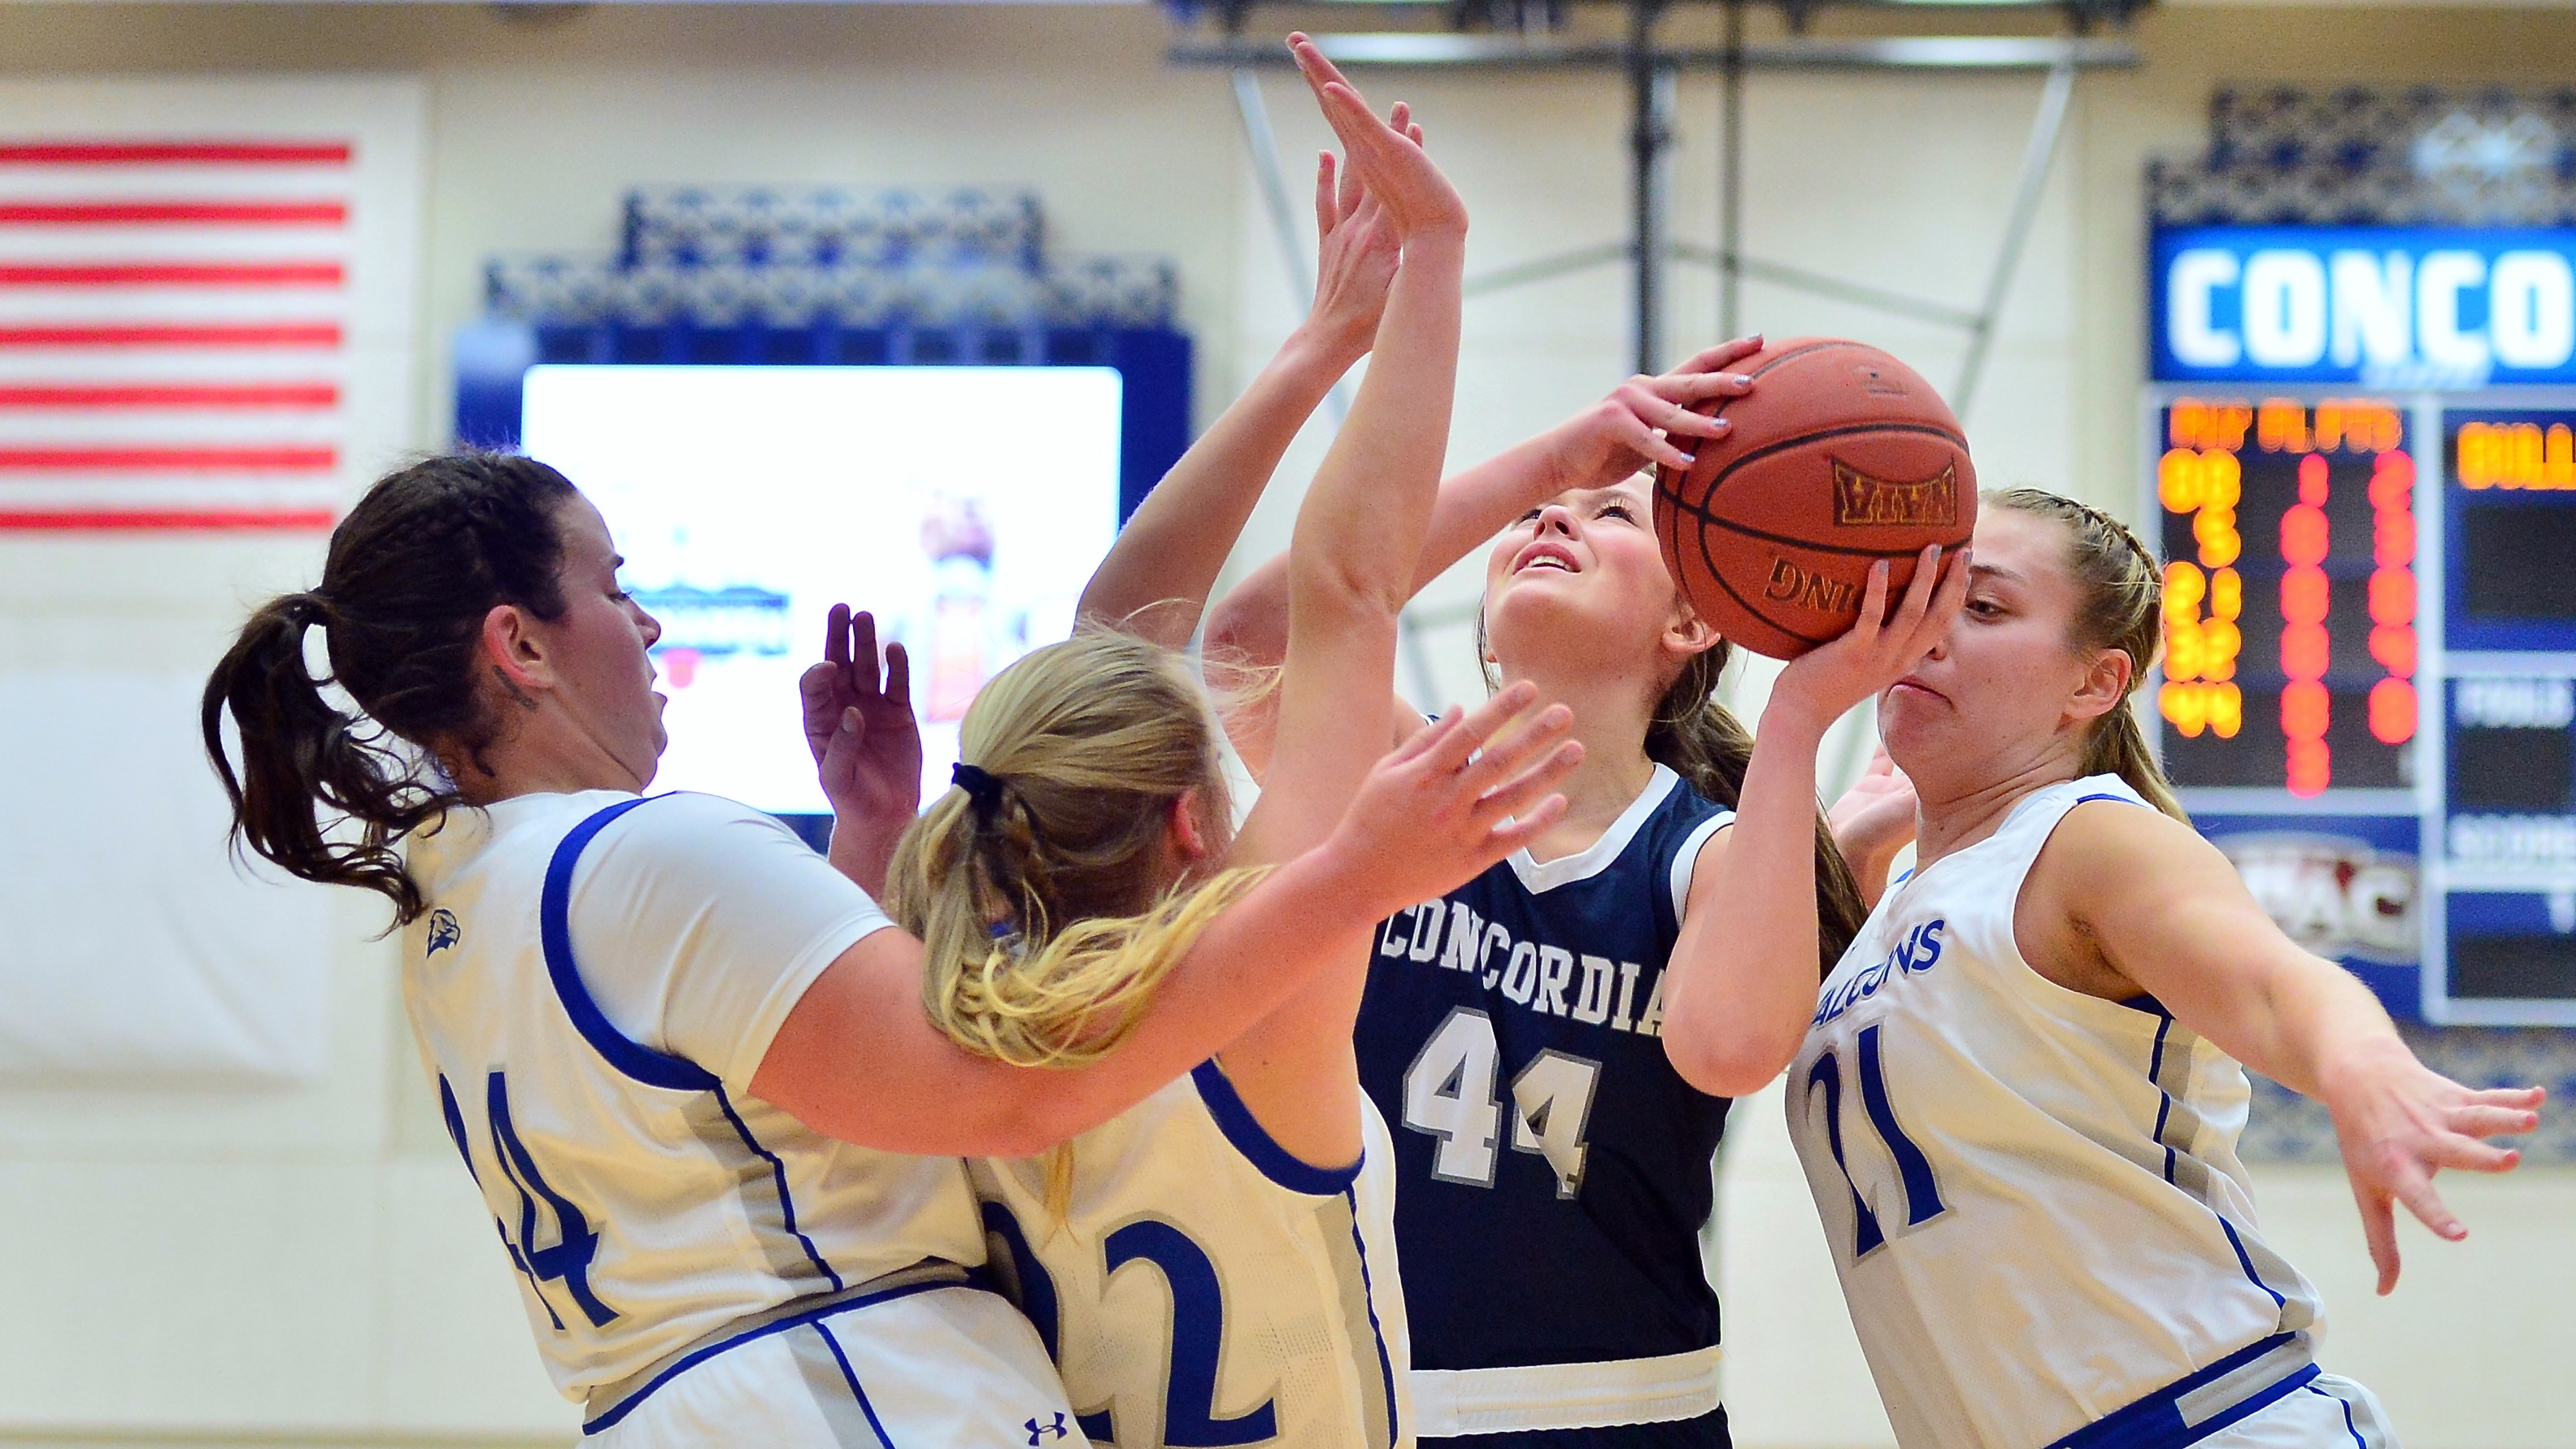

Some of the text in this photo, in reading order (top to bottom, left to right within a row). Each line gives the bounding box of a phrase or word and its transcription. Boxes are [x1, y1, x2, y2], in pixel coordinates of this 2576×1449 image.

[2167, 247, 2575, 368] CONCO
[1763, 555, 1862, 615] ING
[1380, 898, 1666, 1038] CONCORDIA
[1810, 917, 1946, 1028] ALCONS
[1401, 1004, 1603, 1200] 44
[1804, 1016, 1956, 1268] 21
